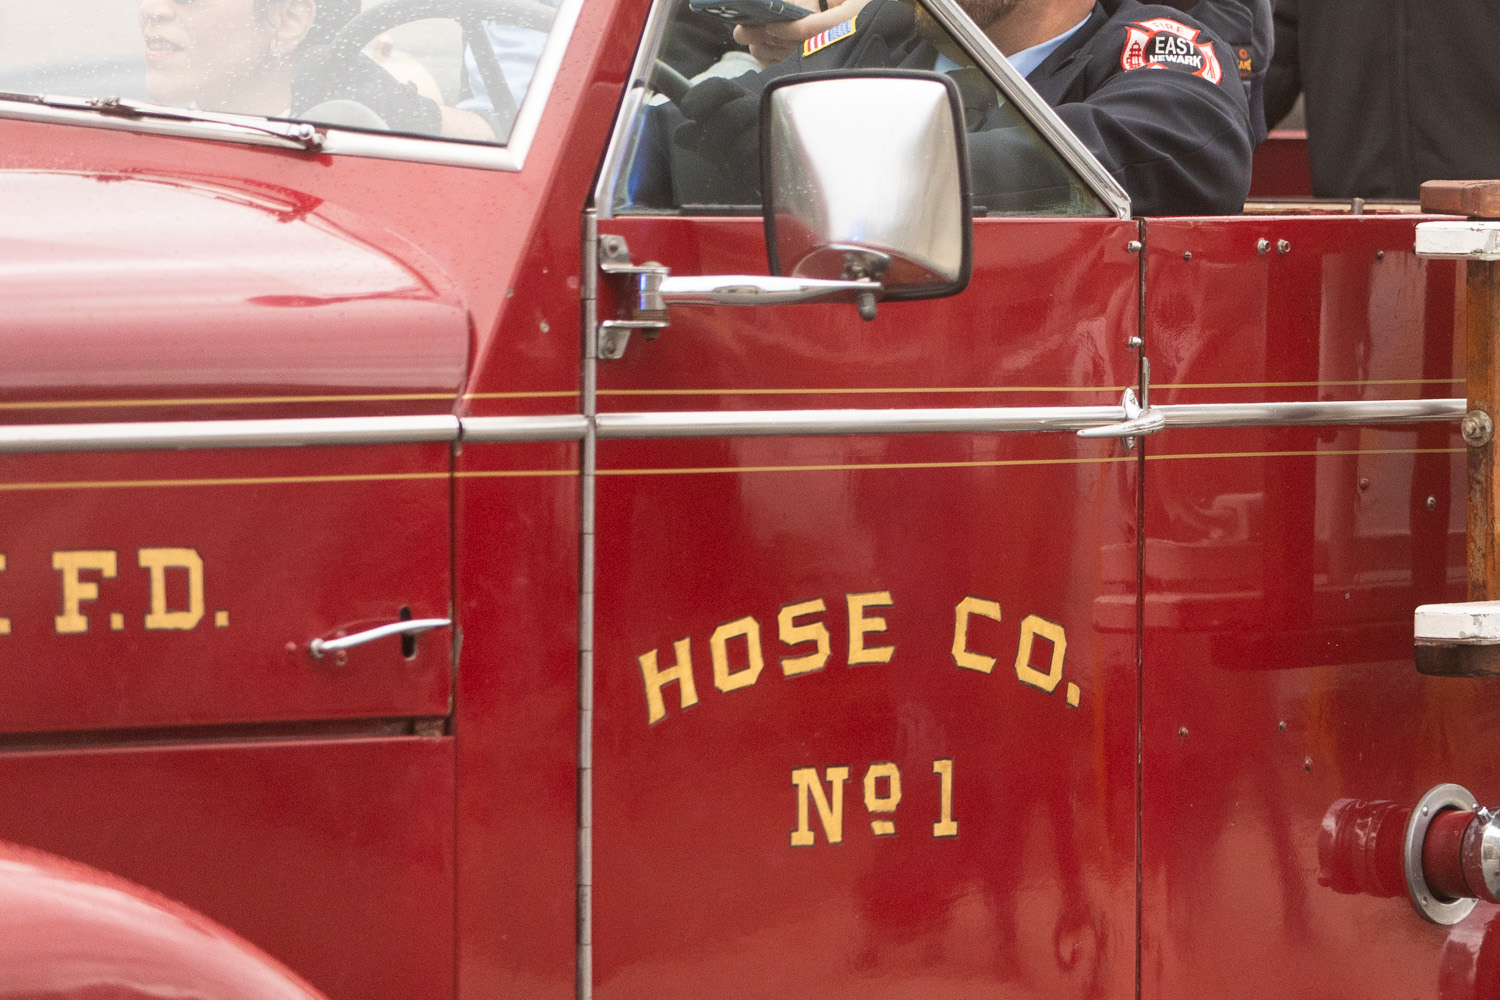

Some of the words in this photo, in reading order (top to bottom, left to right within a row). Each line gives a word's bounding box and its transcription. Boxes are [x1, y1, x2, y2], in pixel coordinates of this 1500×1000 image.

[1152, 21, 1184, 35] FIRE
[1155, 36, 1195, 55] EAST
[1149, 54, 1202, 69] NEWARK
[52, 547, 230, 634] F.D.
[638, 590, 895, 725] HOSE
[951, 595, 1080, 708] CO.
[933, 758, 958, 838] 1
